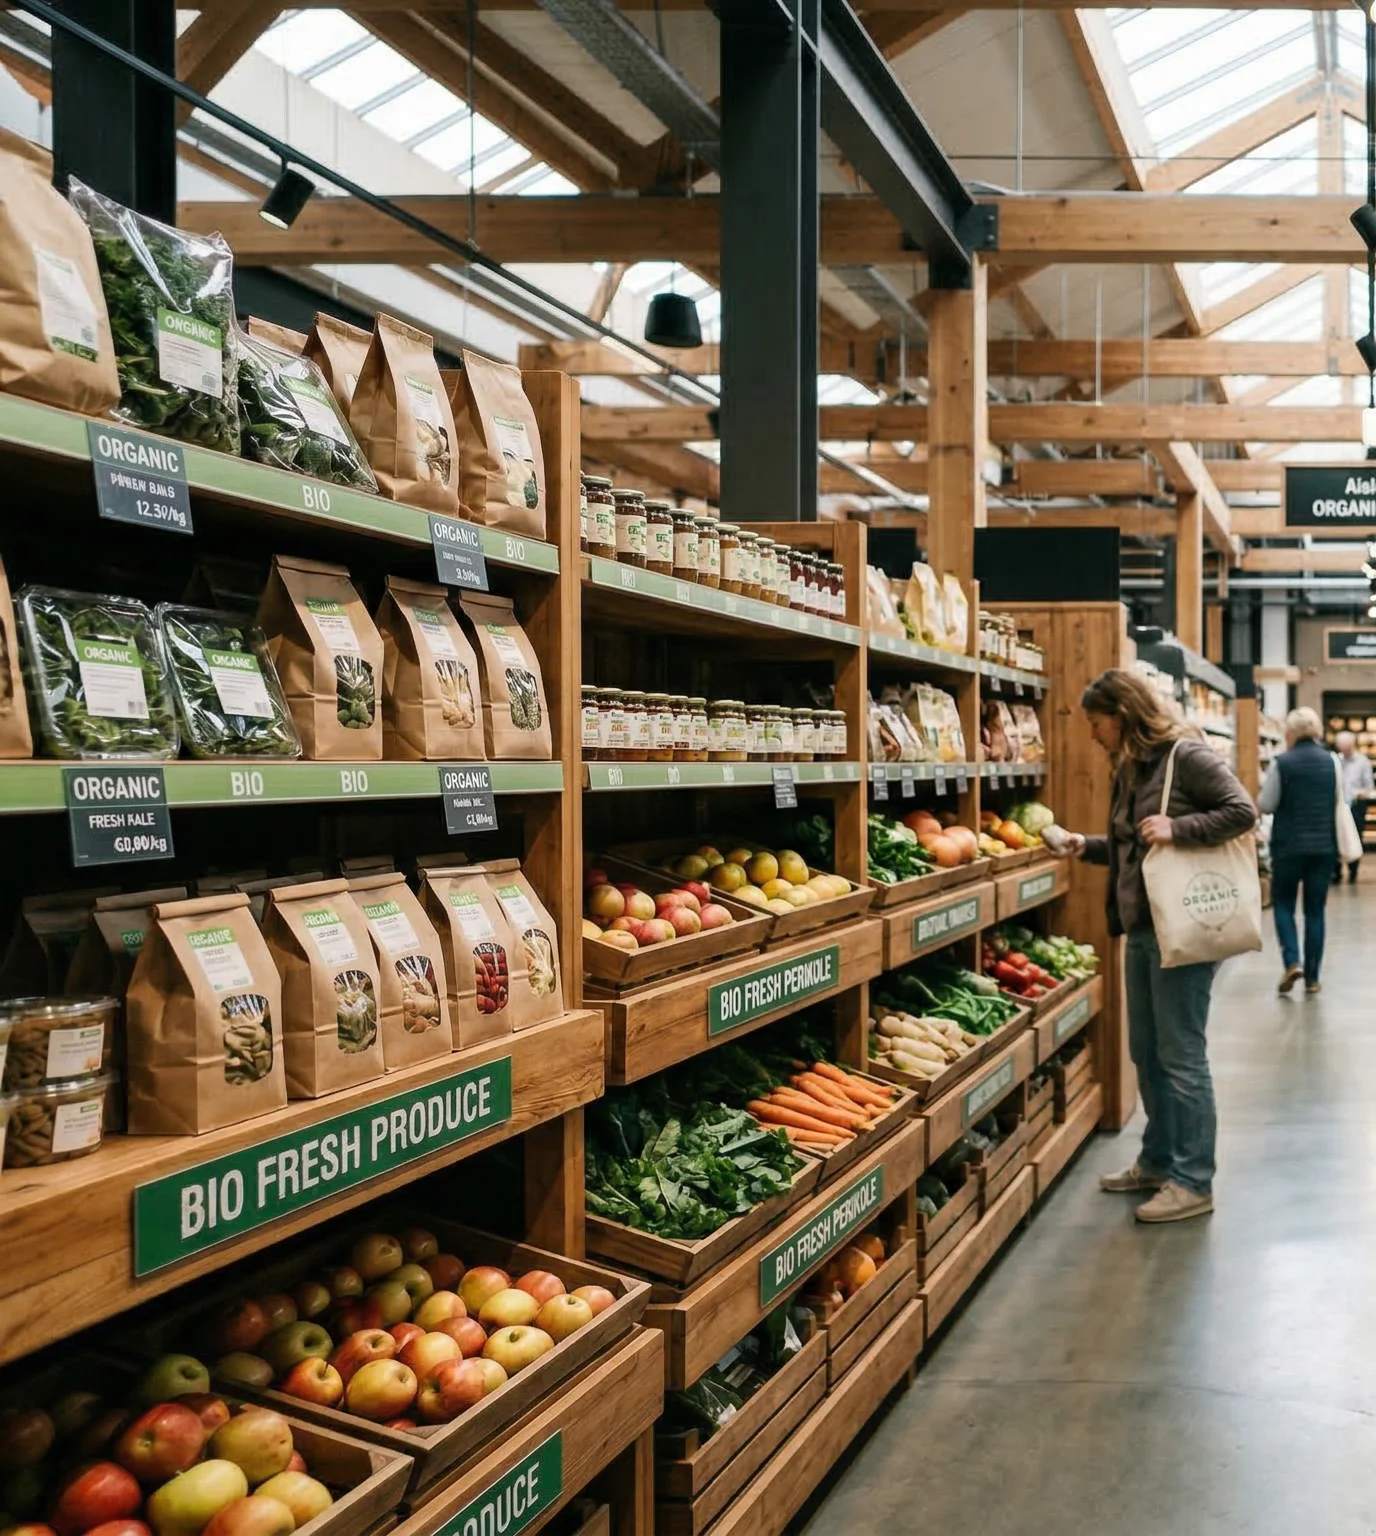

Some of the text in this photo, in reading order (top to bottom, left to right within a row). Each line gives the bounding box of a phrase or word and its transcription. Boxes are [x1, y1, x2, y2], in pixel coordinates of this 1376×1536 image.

[98, 434, 179, 473] ORGANIC
[302, 485, 331, 512] BIO
[434, 522, 479, 547] ORGANIC
[506, 537, 525, 560] BIO
[84, 646, 133, 664] ORGANIC
[73, 776, 161, 800] ORGANIC
[230, 771, 264, 796] BIO
[340, 770, 369, 793] BIO
[444, 772, 489, 790] ORGANIC
[88, 814, 125, 829] FRESH
[1182, 888, 1239, 906] ORGANIC
[720, 986, 742, 1022] BIO
[744, 972, 782, 1012] FRESH
[180, 1076, 491, 1240] BIO FRESH PRODUCE
[775, 1246, 795, 1287] BIO
[797, 1215, 831, 1268] FRESH
